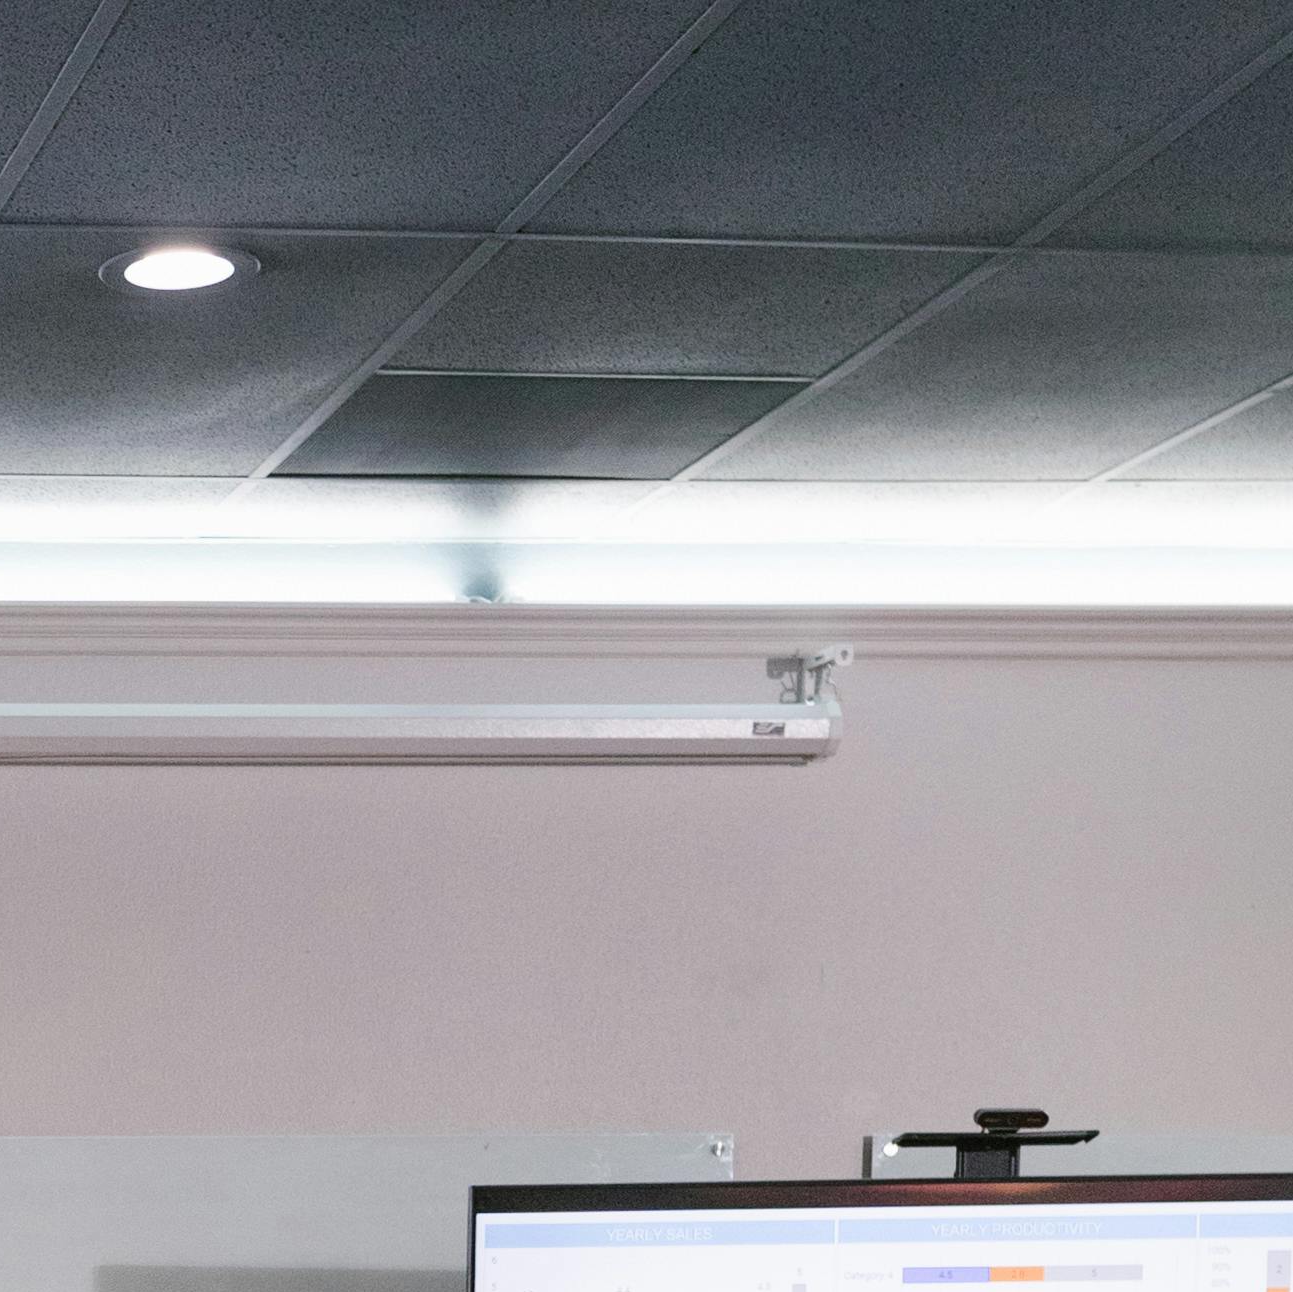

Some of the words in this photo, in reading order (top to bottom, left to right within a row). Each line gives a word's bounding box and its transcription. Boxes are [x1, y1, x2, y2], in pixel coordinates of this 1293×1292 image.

[605, 1228, 663, 1242] YEARLY
[666, 1226, 713, 1241] SALES
[931, 1223, 988, 1236] YEARLY
[993, 1221, 1101, 1235] PRODUCTIVITY
[844, 1270, 884, 1282] Category
